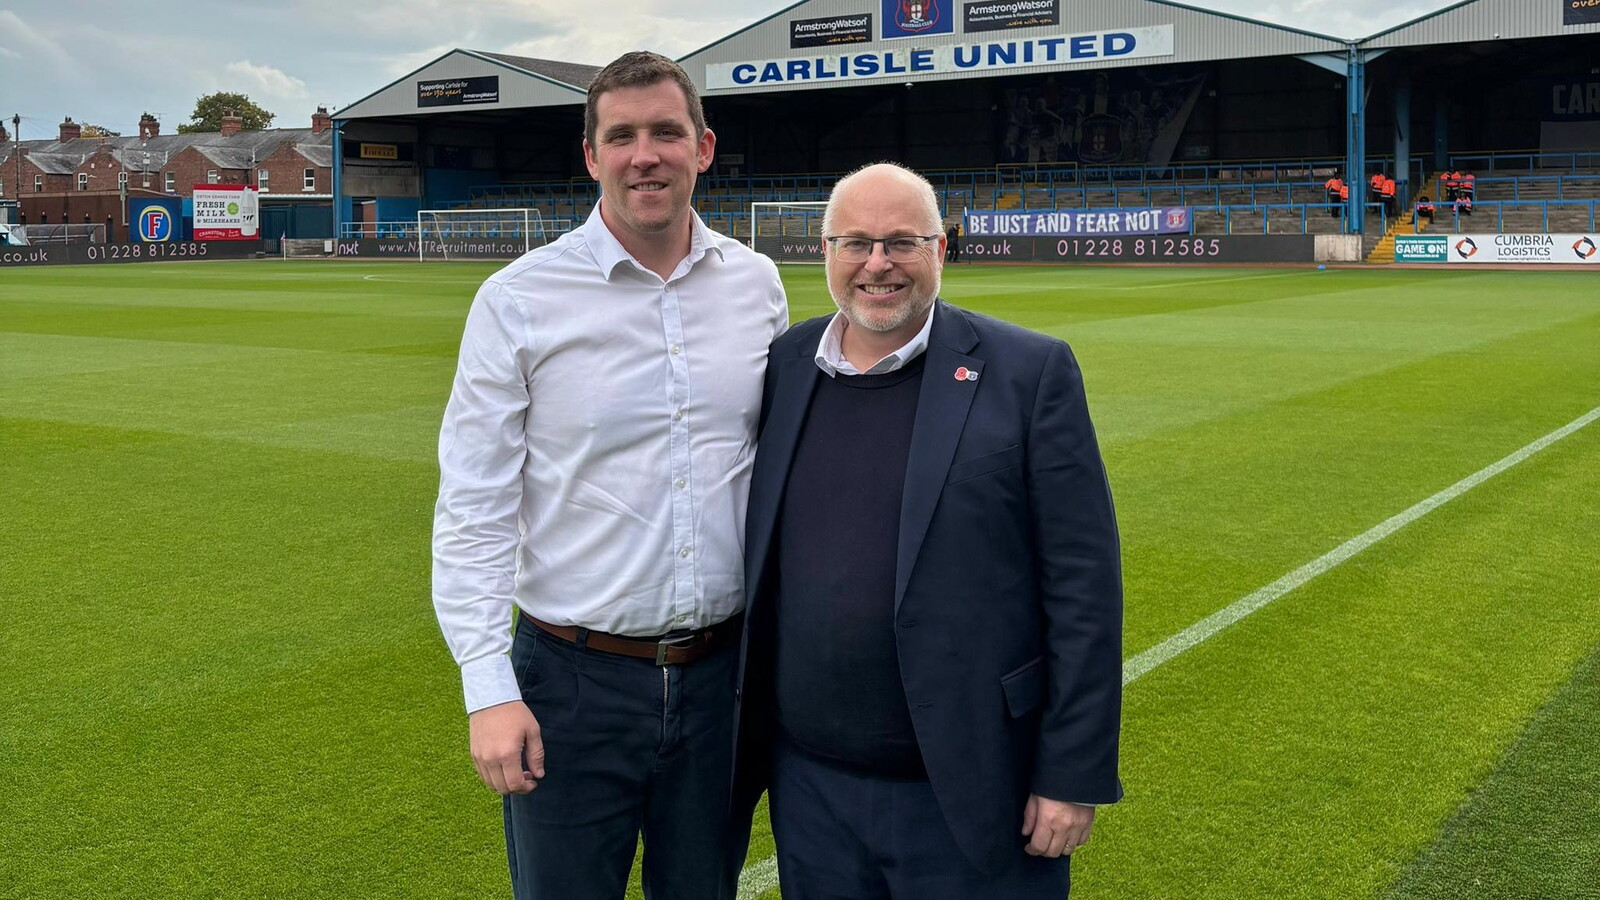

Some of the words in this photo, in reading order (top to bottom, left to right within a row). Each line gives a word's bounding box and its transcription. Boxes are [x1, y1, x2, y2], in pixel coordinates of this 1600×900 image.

[968, 0, 1052, 15] ArmstrongWatson
[795, 19, 866, 32] ArmstrongWatson
[732, 49, 935, 84] CARLISLE
[954, 33, 1136, 68] UNITED
[970, 214, 989, 234] BE
[992, 214, 1031, 234] JUST
[1035, 212, 1071, 233] AND
[1076, 212, 1120, 233] FEAR
[1125, 209, 1162, 232] NOT
[379, 240, 529, 254] www.NXTRecruitment.co.u
[1056, 239, 1123, 256] 01228
[1134, 239, 1220, 256] 812585
[1494, 234, 1554, 246] CUMBRIA
[87, 244, 142, 260] 01228
[149, 243, 208, 257] 812585
[339, 240, 359, 256] nxt
[1395, 244, 1426, 254] GAME
[1427, 244, 1447, 254] ON!
[1498, 247, 1551, 256] LOGISTICS
